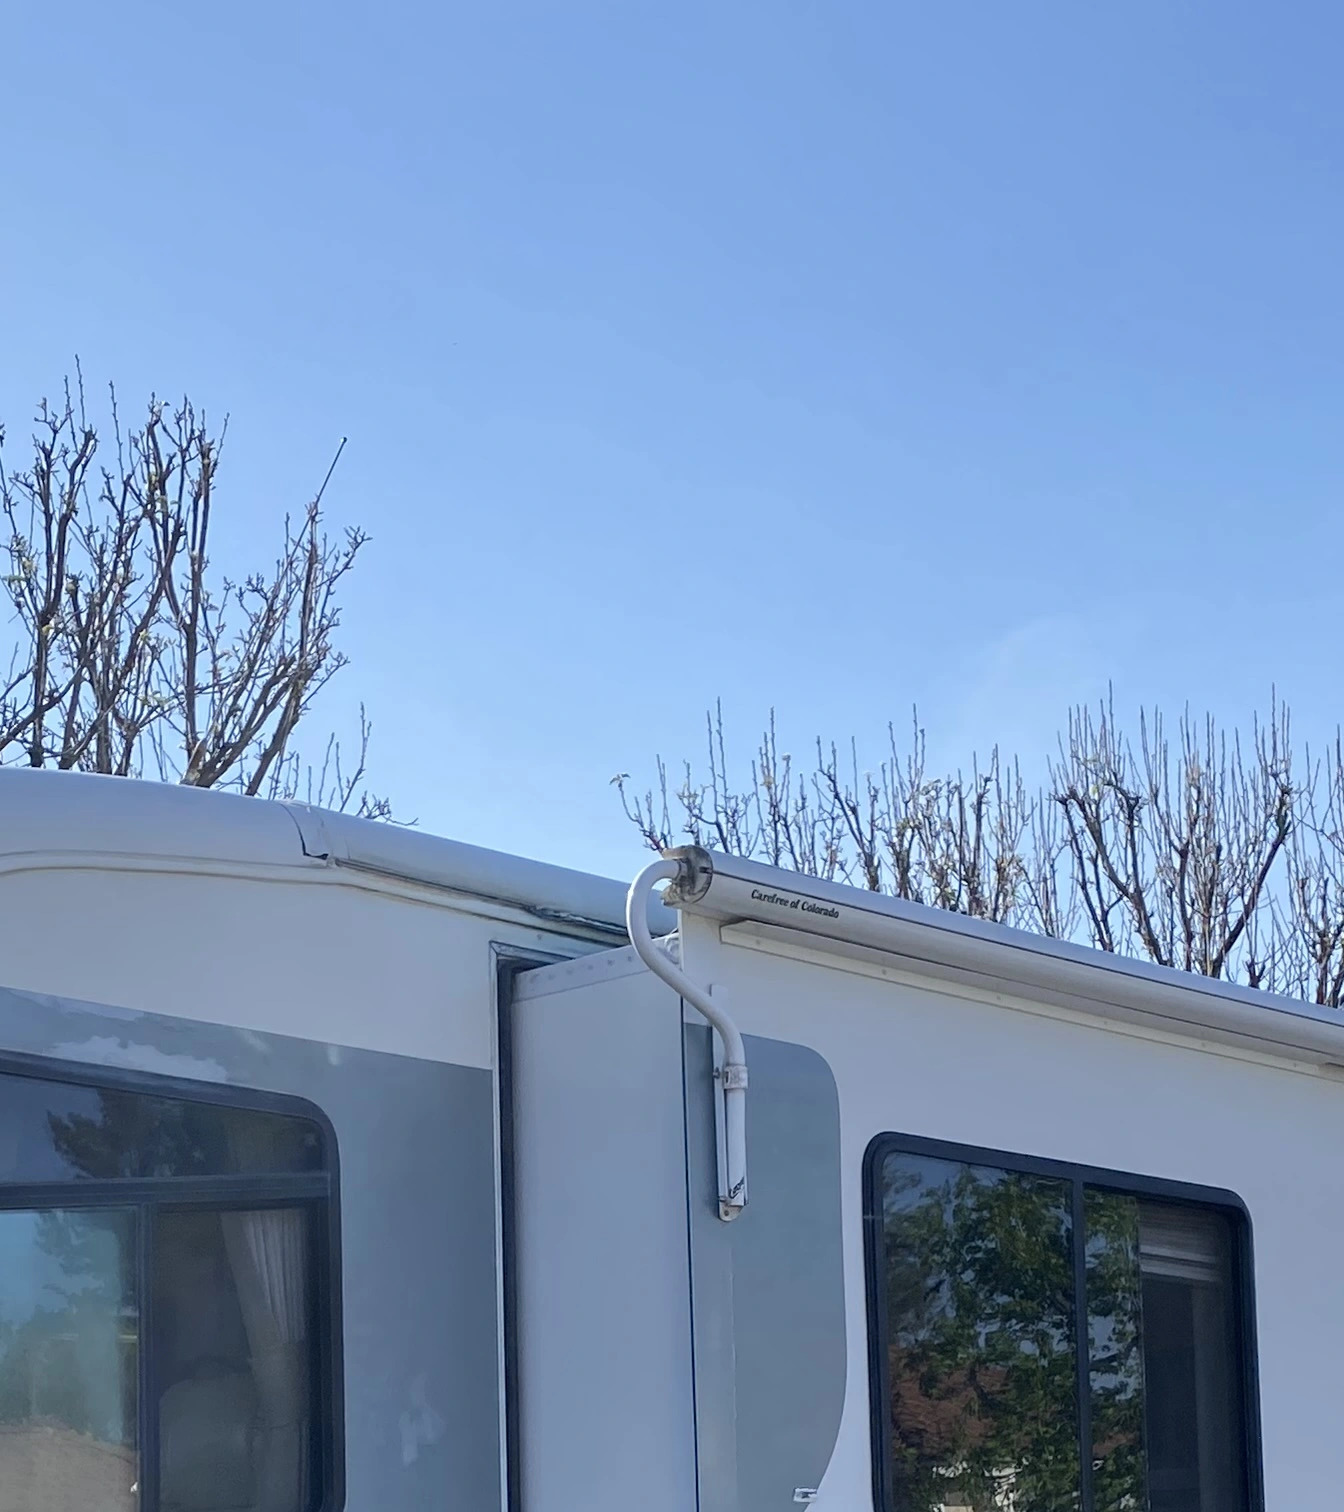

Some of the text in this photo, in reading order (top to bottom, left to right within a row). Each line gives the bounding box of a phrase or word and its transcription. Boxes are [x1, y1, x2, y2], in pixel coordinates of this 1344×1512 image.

[751, 889, 840, 919] Carefree of Colorado
